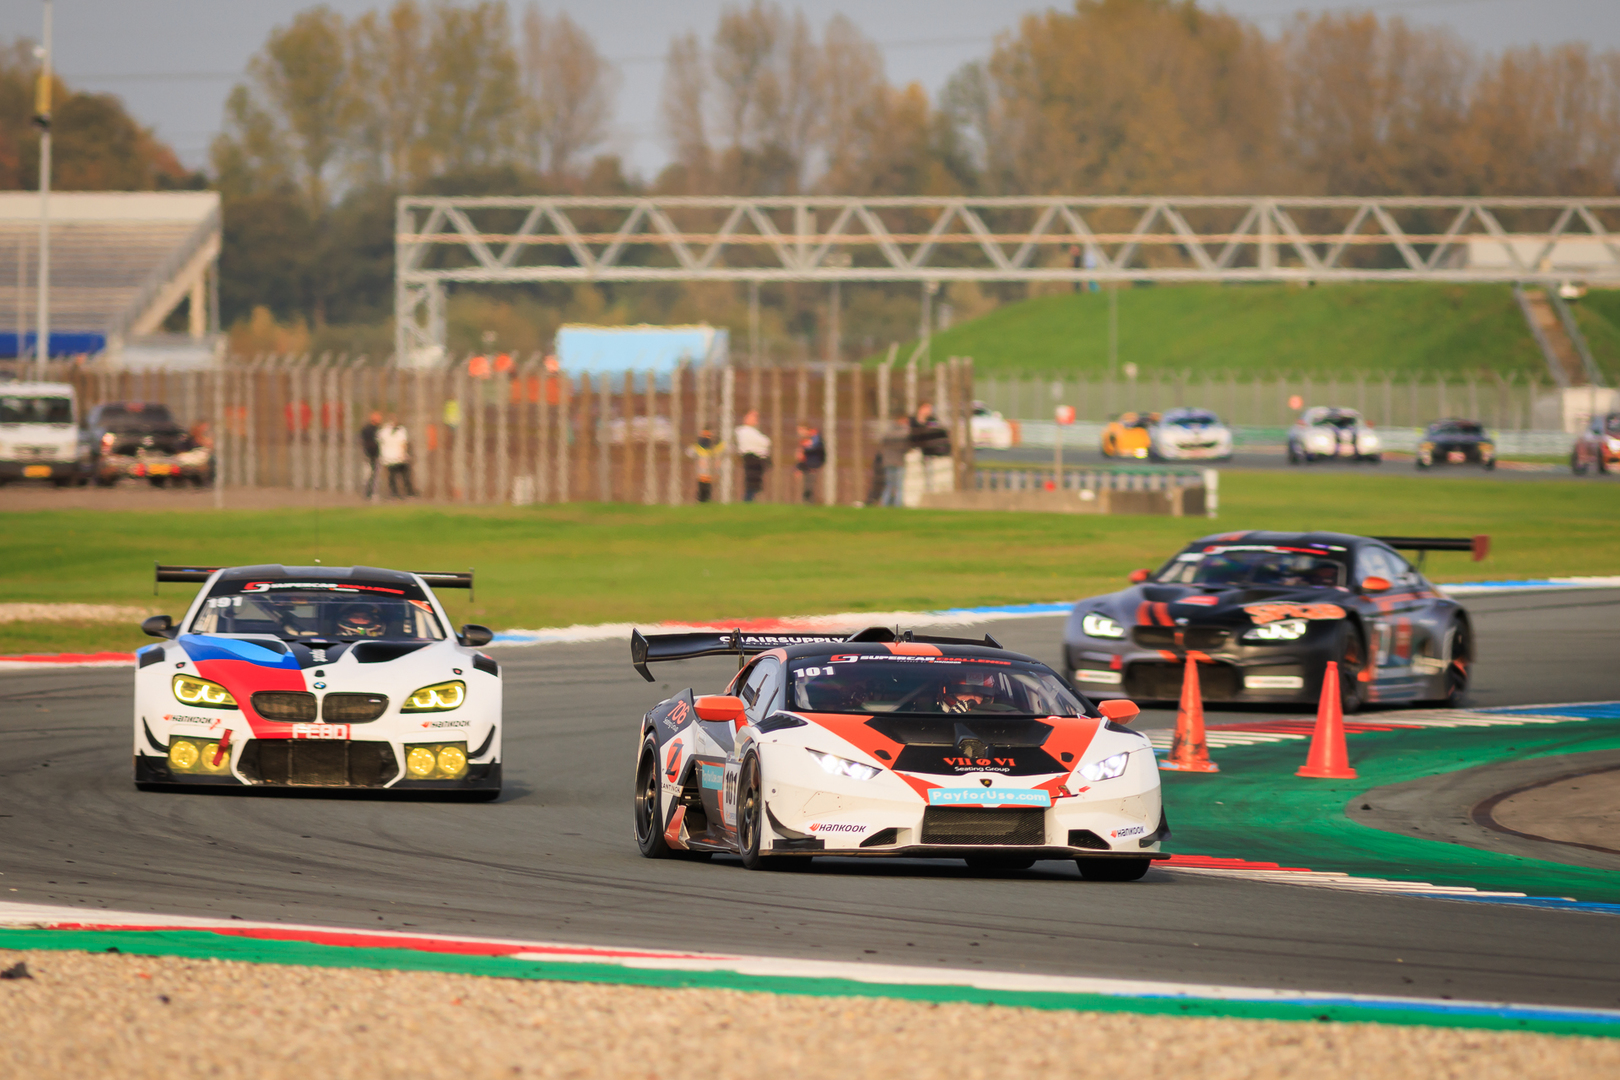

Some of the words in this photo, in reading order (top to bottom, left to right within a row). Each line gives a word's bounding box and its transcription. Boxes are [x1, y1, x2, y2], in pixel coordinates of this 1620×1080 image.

[208, 597, 243, 608] 191
[793, 666, 834, 678] 101
[725, 770, 737, 805] 101
[932, 790, 1046, 801] PayforUse.com
